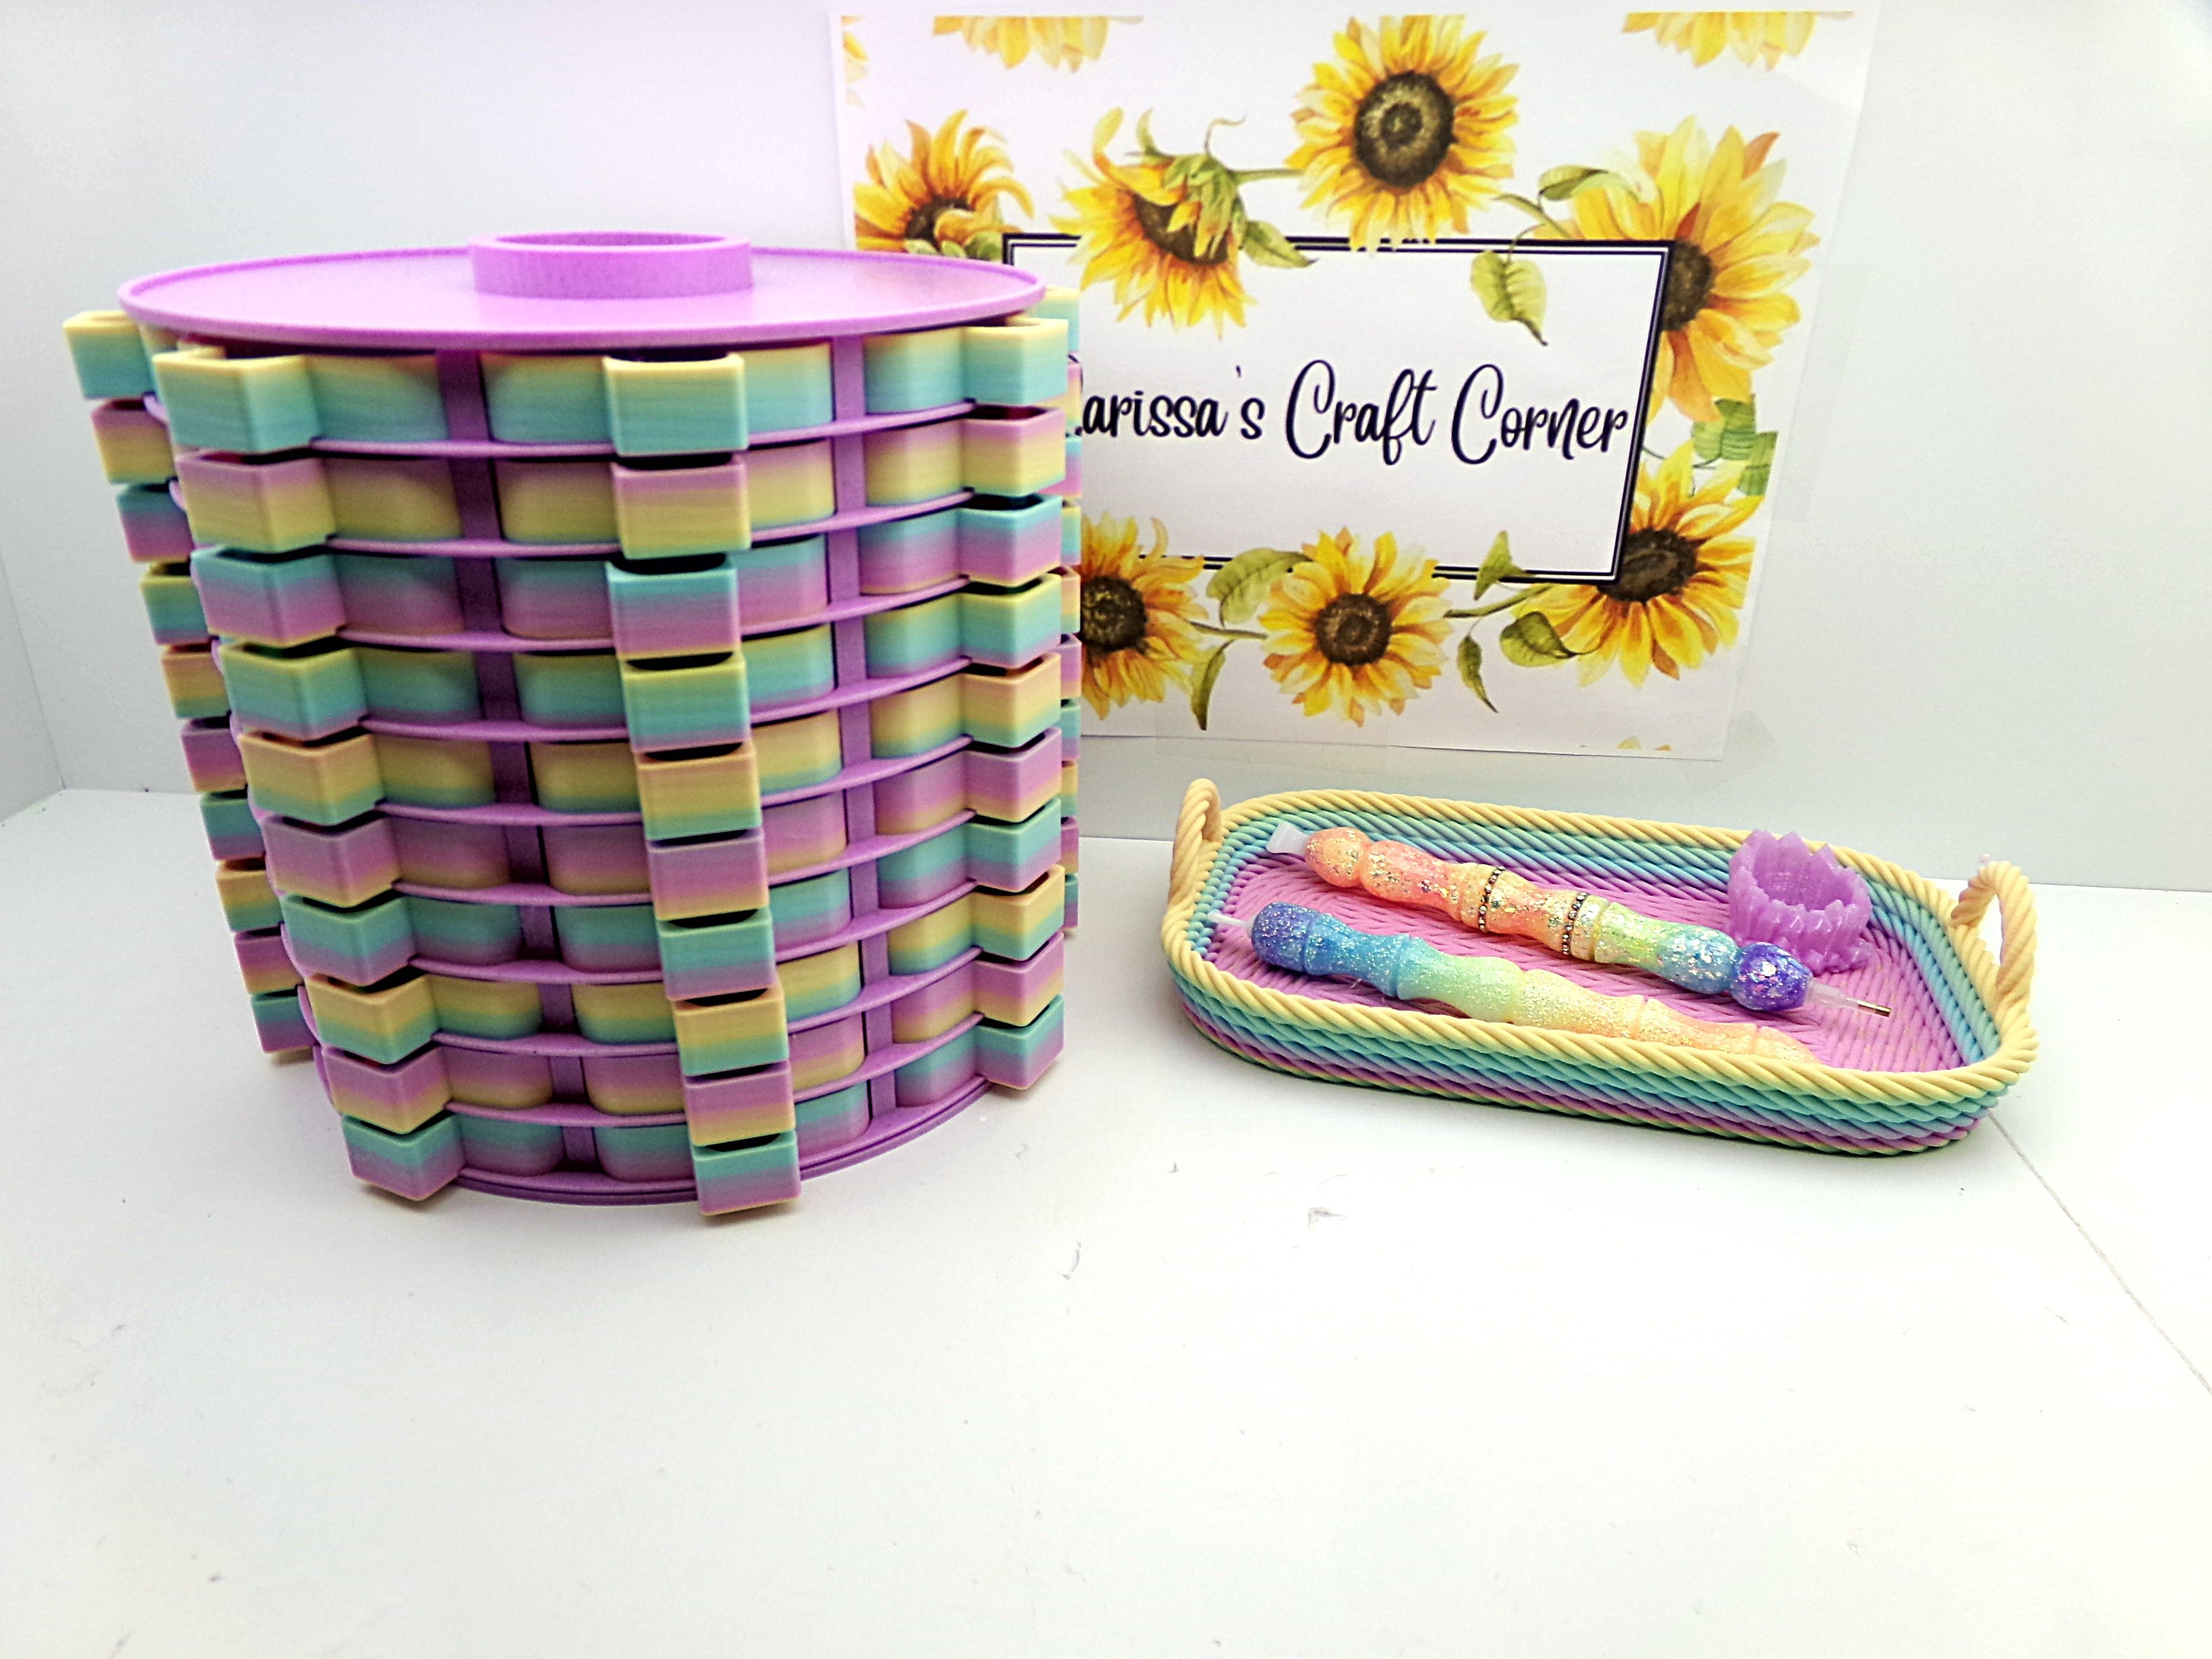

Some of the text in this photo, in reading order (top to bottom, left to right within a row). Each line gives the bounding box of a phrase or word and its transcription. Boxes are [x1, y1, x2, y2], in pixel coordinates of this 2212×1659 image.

[1067, 356, 1628, 466] arissa's Craft Corner
